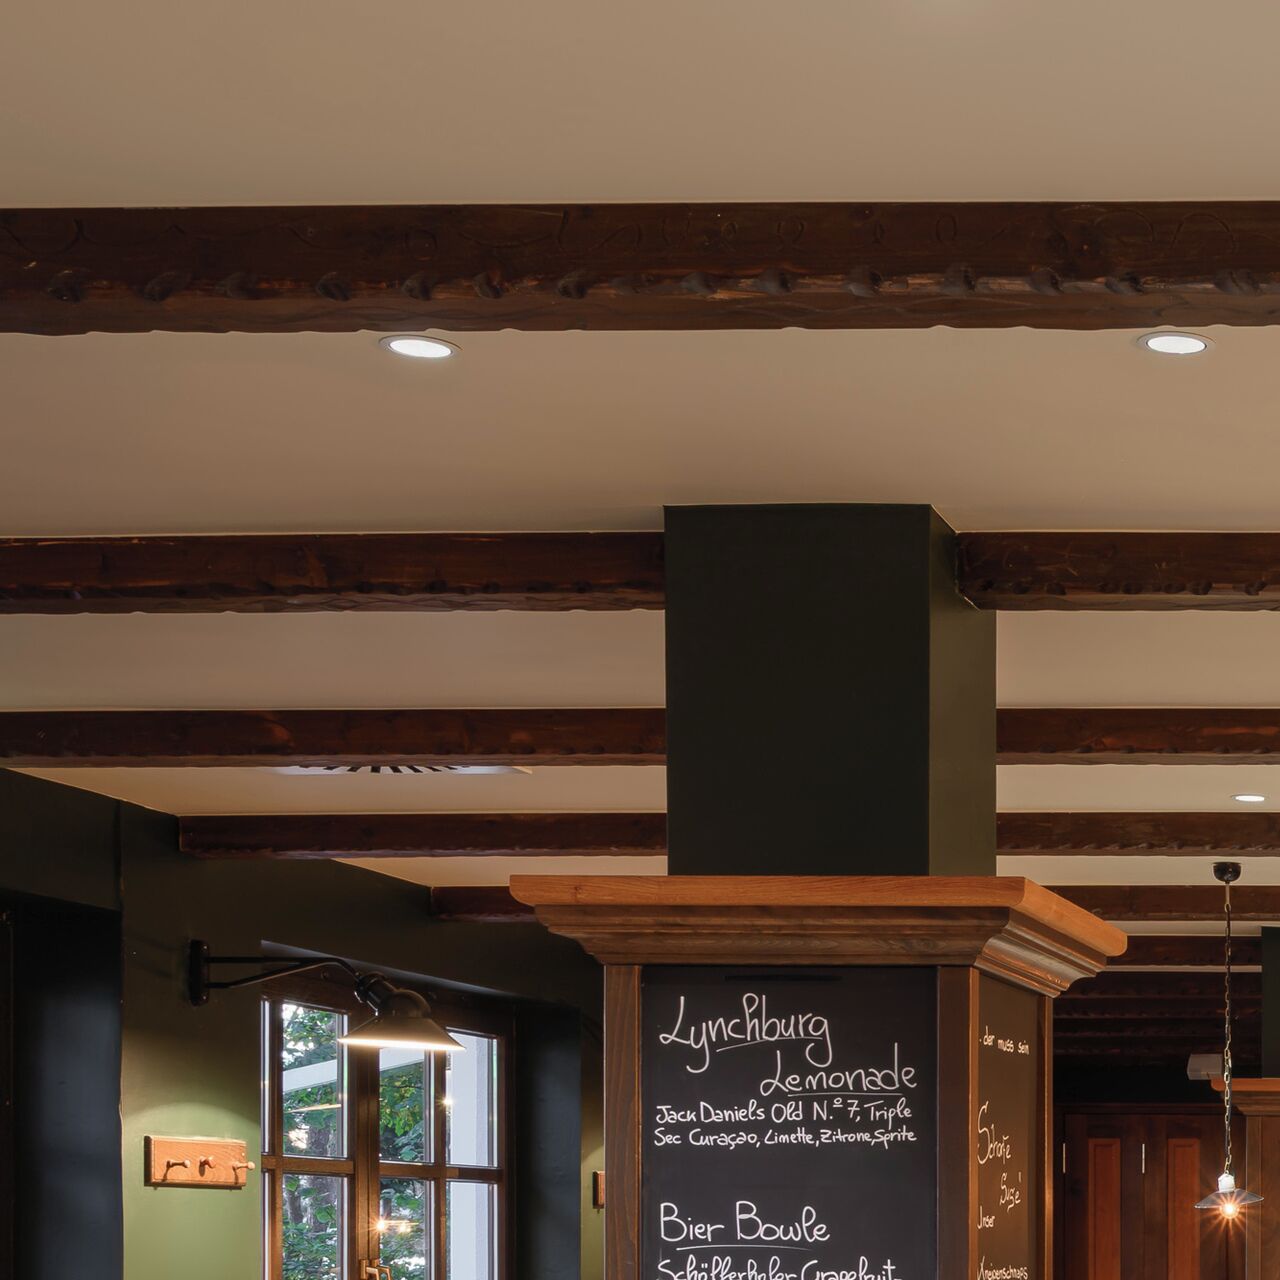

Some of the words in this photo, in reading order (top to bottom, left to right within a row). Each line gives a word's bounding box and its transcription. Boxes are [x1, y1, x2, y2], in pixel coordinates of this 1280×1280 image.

[659, 993, 832, 1073] Lynchburg
[760, 1043, 917, 1096] Lemonade
[656, 1105, 697, 1123] Jack
[700, 1099, 765, 1122] Daniels
[772, 1101, 802, 1122] Old
[847, 1100, 861, 1122] 7,
[864, 1097, 912, 1130] Triple
[654, 1128, 682, 1145] Sec
[689, 1129, 760, 1149] Curaçao,
[764, 1127, 819, 1147] Limette,
[660, 1202, 725, 1241] Bier
[736, 1200, 830, 1242] Bowle
